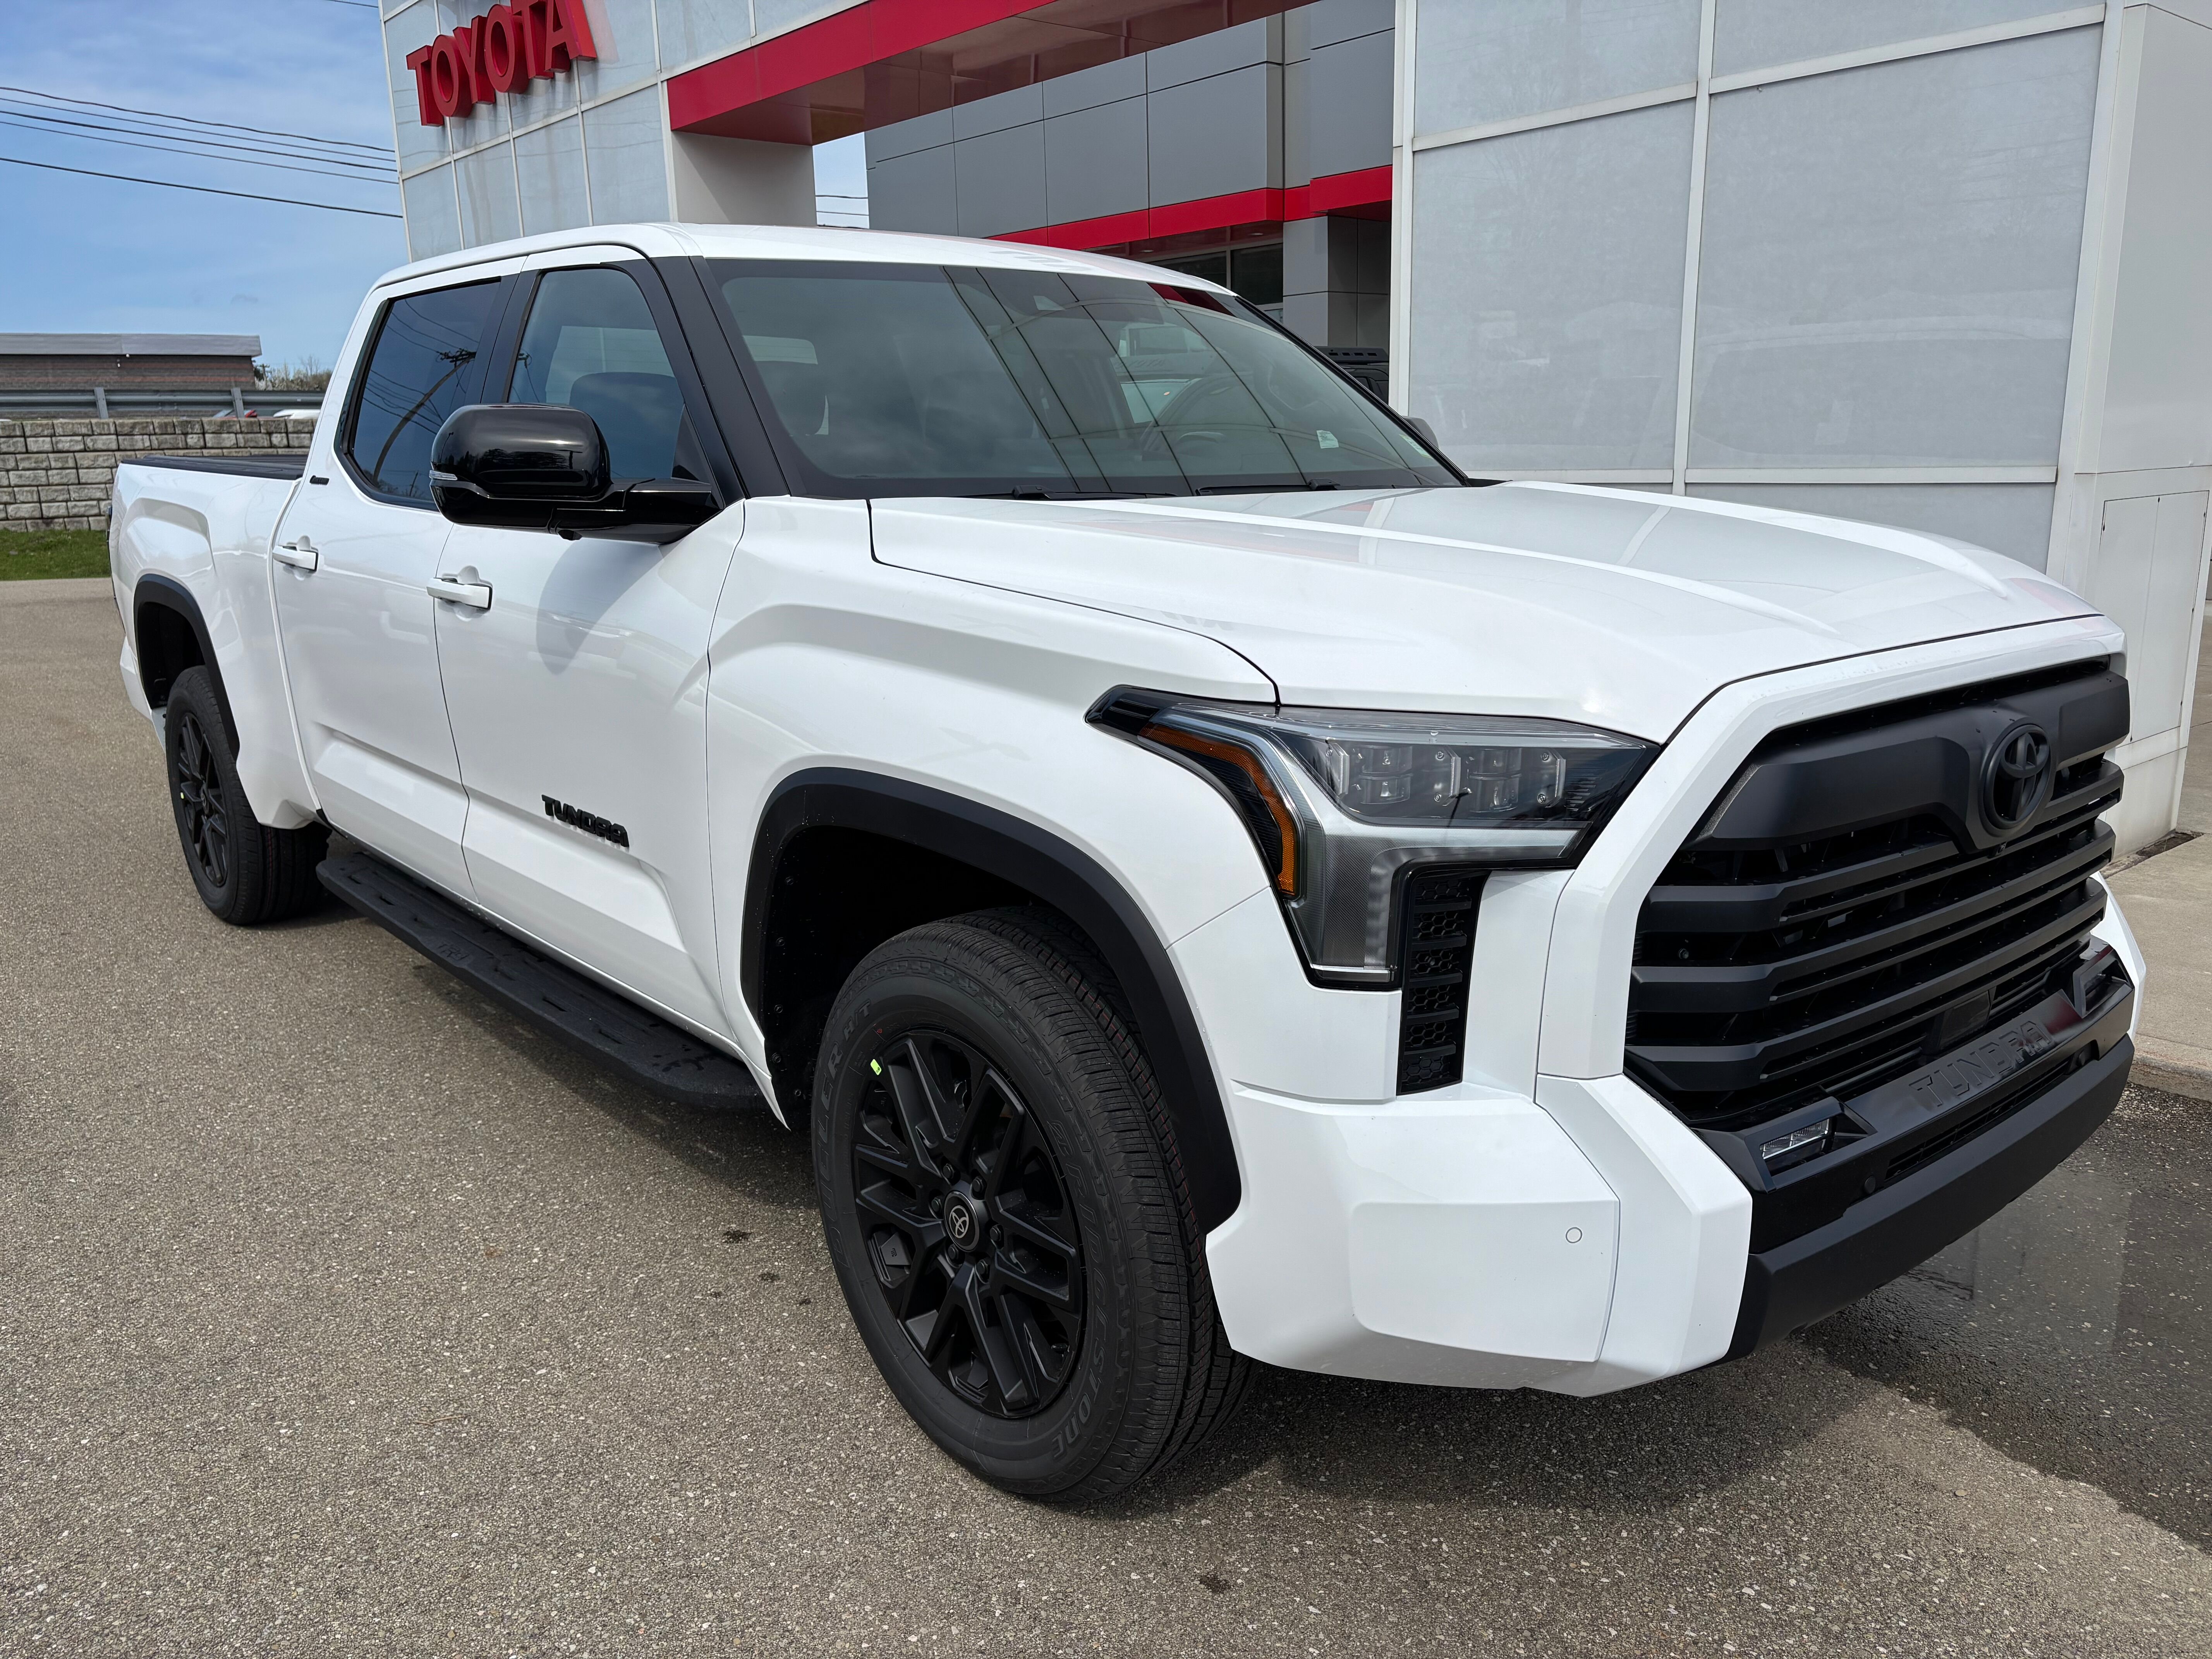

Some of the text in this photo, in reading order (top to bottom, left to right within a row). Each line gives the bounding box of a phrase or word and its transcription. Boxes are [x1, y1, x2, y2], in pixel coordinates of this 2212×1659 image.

[406, 0, 597, 126] TOYOTA
[541, 794, 629, 847] TUNDRA
[1909, 1020, 2052, 1107] TUNDRA
[1047, 1118, 1109, 1460] BRIDGESTONE
